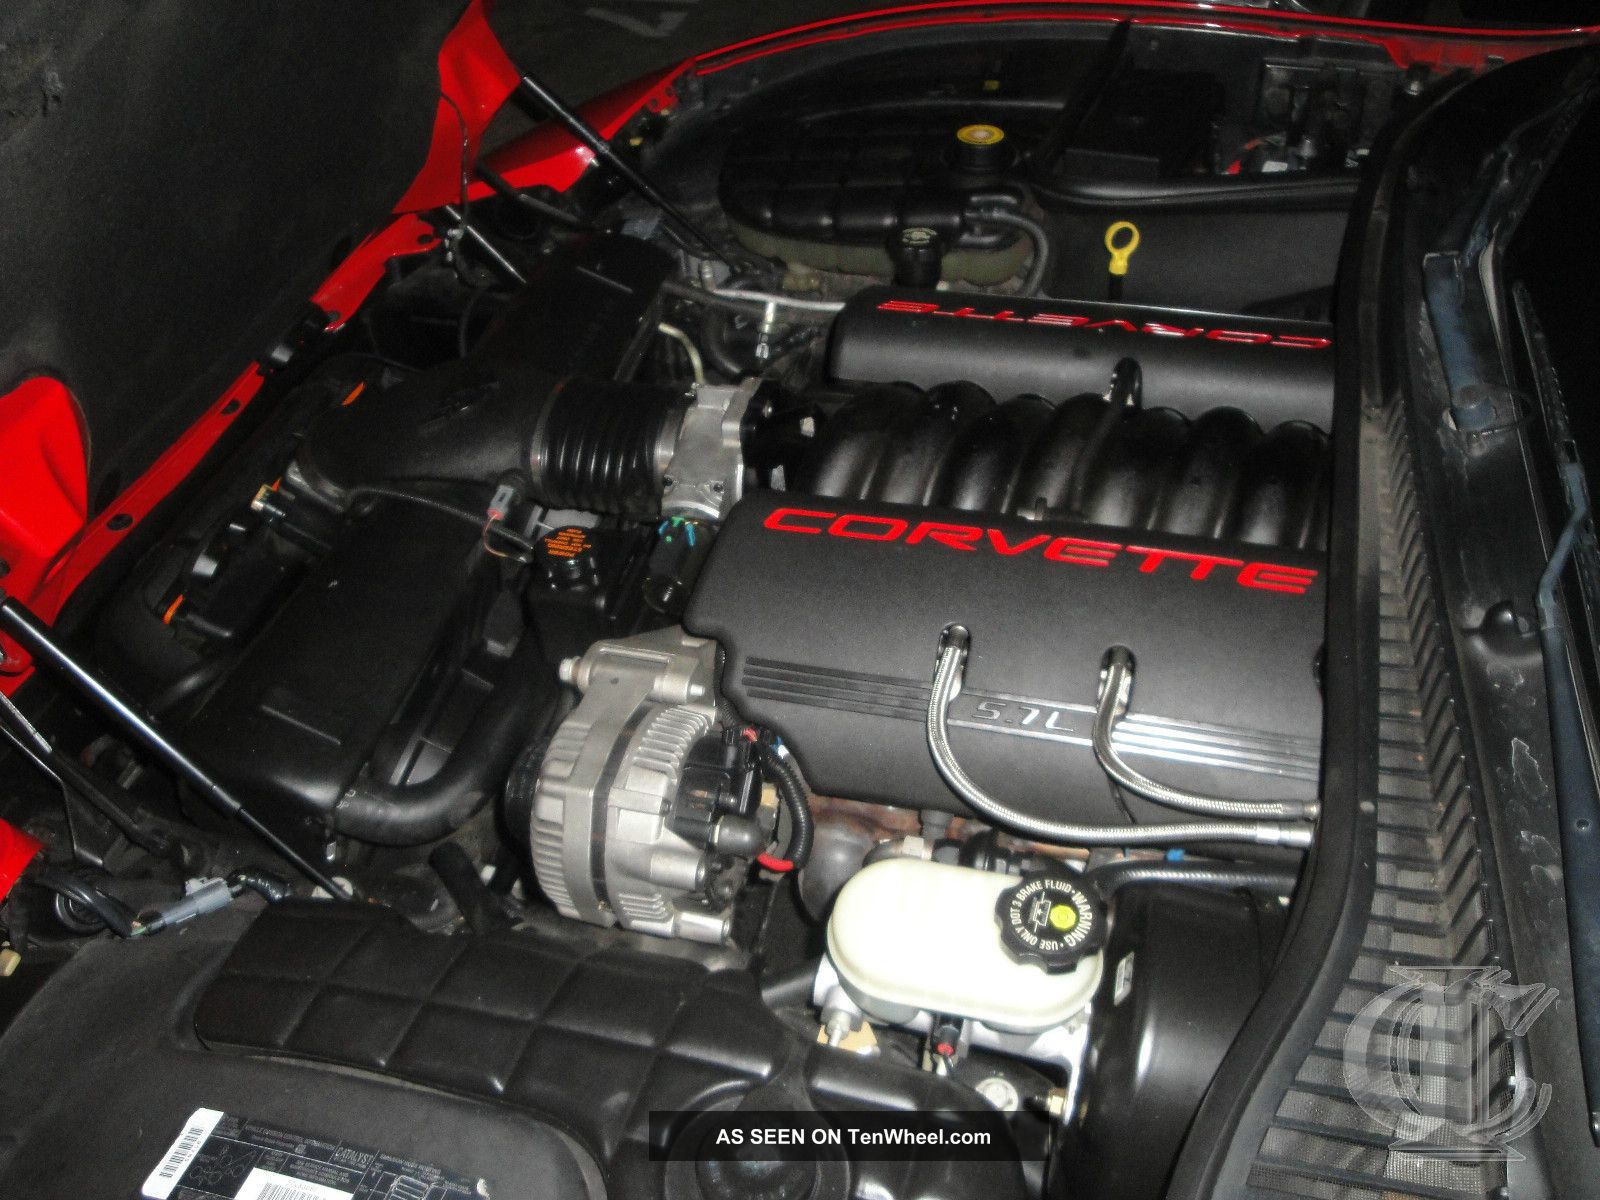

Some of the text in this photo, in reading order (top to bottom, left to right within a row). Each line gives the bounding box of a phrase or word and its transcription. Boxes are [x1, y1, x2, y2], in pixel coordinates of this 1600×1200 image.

[877, 300, 1333, 348] CORVETTE
[763, 508, 1318, 594] CORVETTE
[971, 701, 1075, 732] 5.7L
[1010, 879, 1093, 951] USE ONLY DOT 3 BRAKE FLUID WARNING
